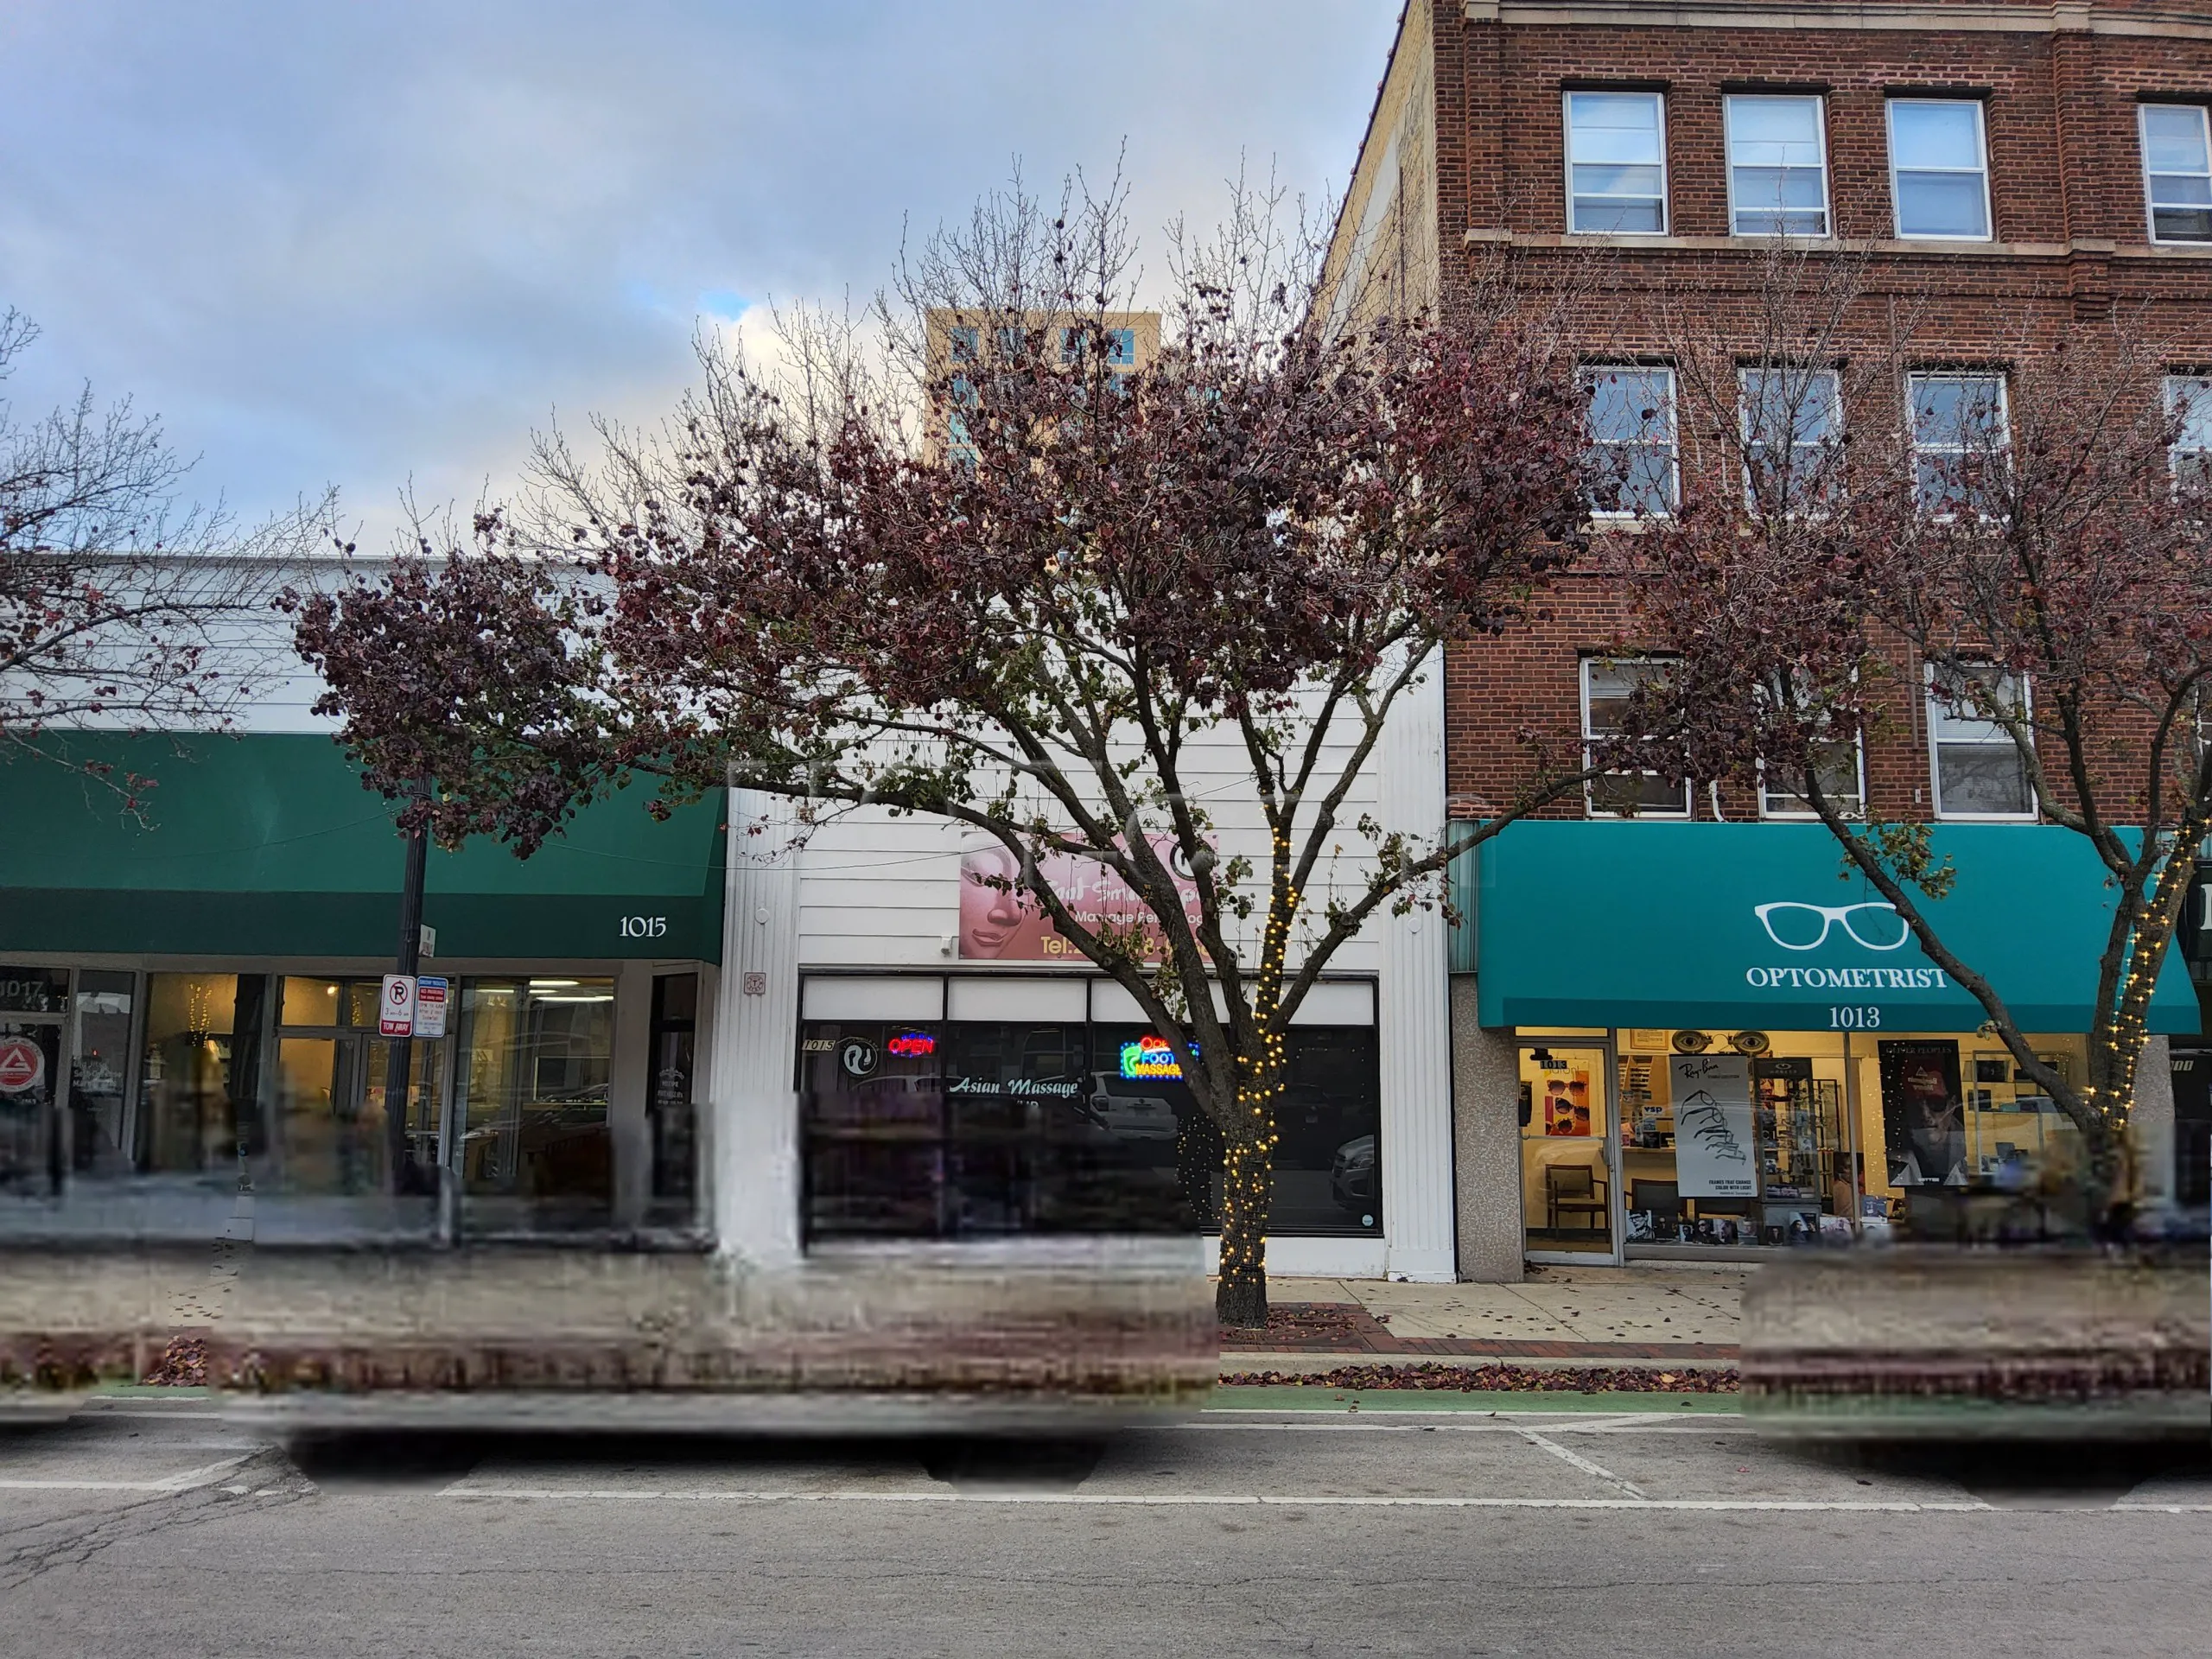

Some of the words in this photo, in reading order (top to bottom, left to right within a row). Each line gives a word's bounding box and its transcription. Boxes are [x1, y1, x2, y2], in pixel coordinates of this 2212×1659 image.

[620, 916, 666, 937] 1015
[1745, 967, 1948, 988] OPTOMETRIST
[383, 1021, 394, 1031] TOW
[394, 1022, 410, 1033] AWAY
[1829, 1007, 1880, 1027] 1013
[803, 1039, 835, 1051] 1015
[888, 1039, 934, 1053] OPEN
[1541, 1060, 1567, 1069] 1013
[1679, 1058, 1719, 1079] Ray-Ban
[950, 1077, 1001, 1094] Asian
[1007, 1079, 1078, 1098] Massage
